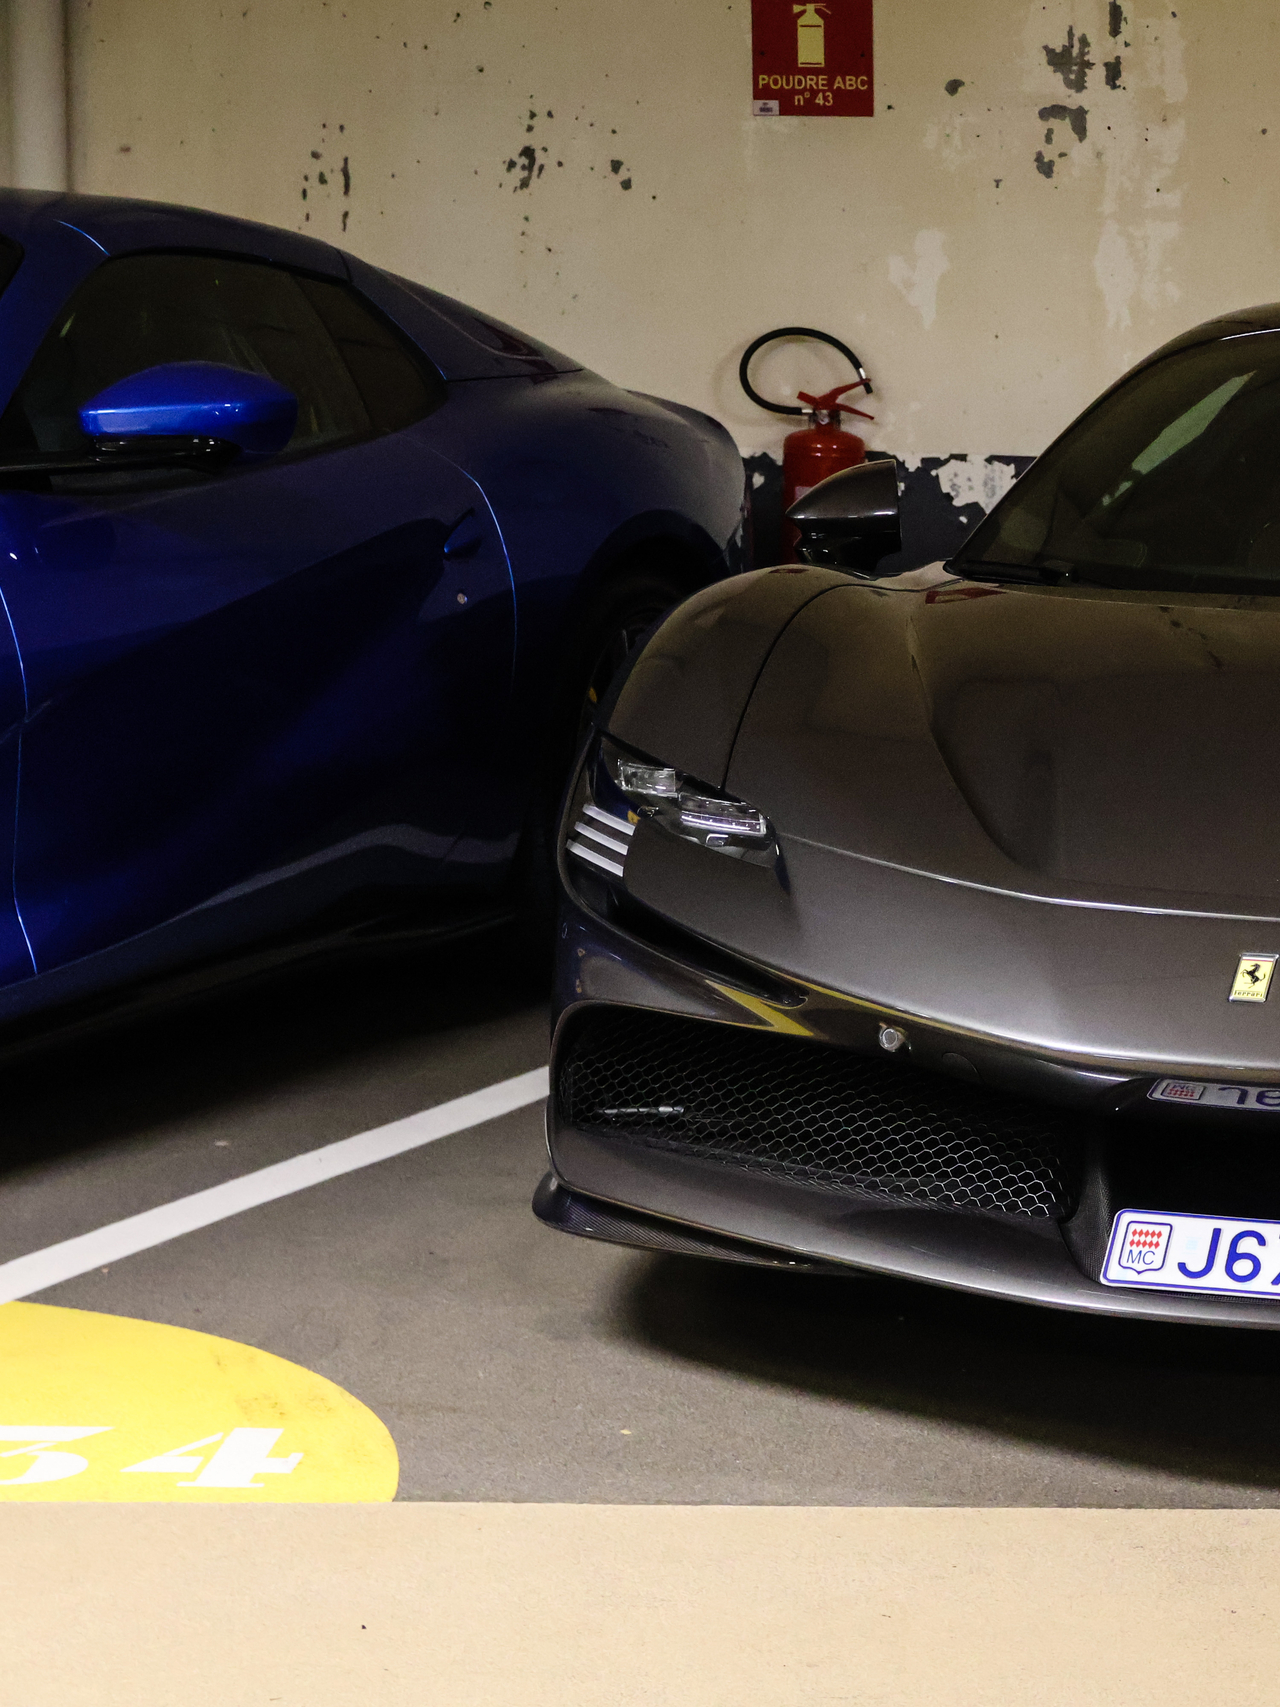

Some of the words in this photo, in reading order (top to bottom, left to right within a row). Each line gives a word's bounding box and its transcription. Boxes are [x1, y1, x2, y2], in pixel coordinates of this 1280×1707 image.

[758, 75, 828, 90] POUDRE
[833, 76, 868, 90] ABC
[815, 92, 833, 106] 43
[1126, 1249, 1156, 1266] MC
